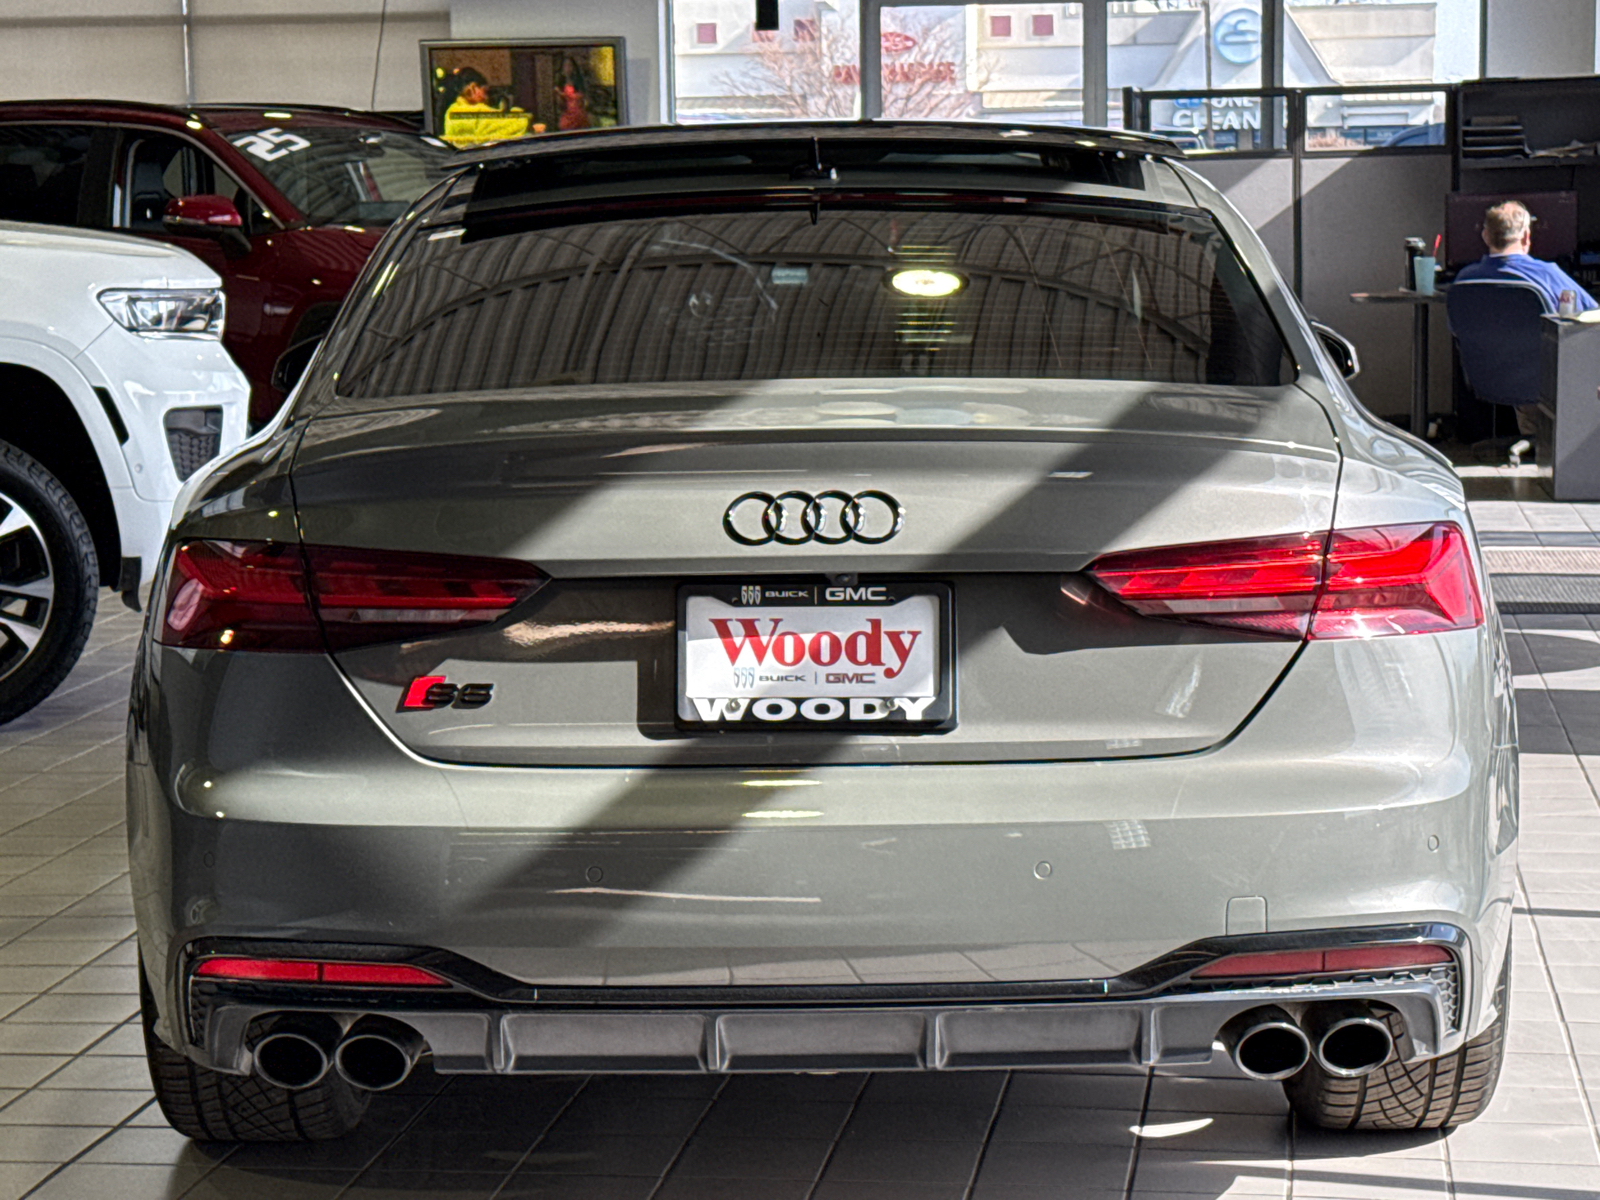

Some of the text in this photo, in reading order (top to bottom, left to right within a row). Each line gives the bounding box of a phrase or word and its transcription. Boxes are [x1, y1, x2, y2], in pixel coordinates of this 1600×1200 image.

[232, 127, 311, 162] 25
[765, 587, 887, 601] BUICK GMC
[708, 618, 922, 679] Woody
[759, 672, 876, 684] BUICK GMC
[692, 697, 937, 721] WOODY
